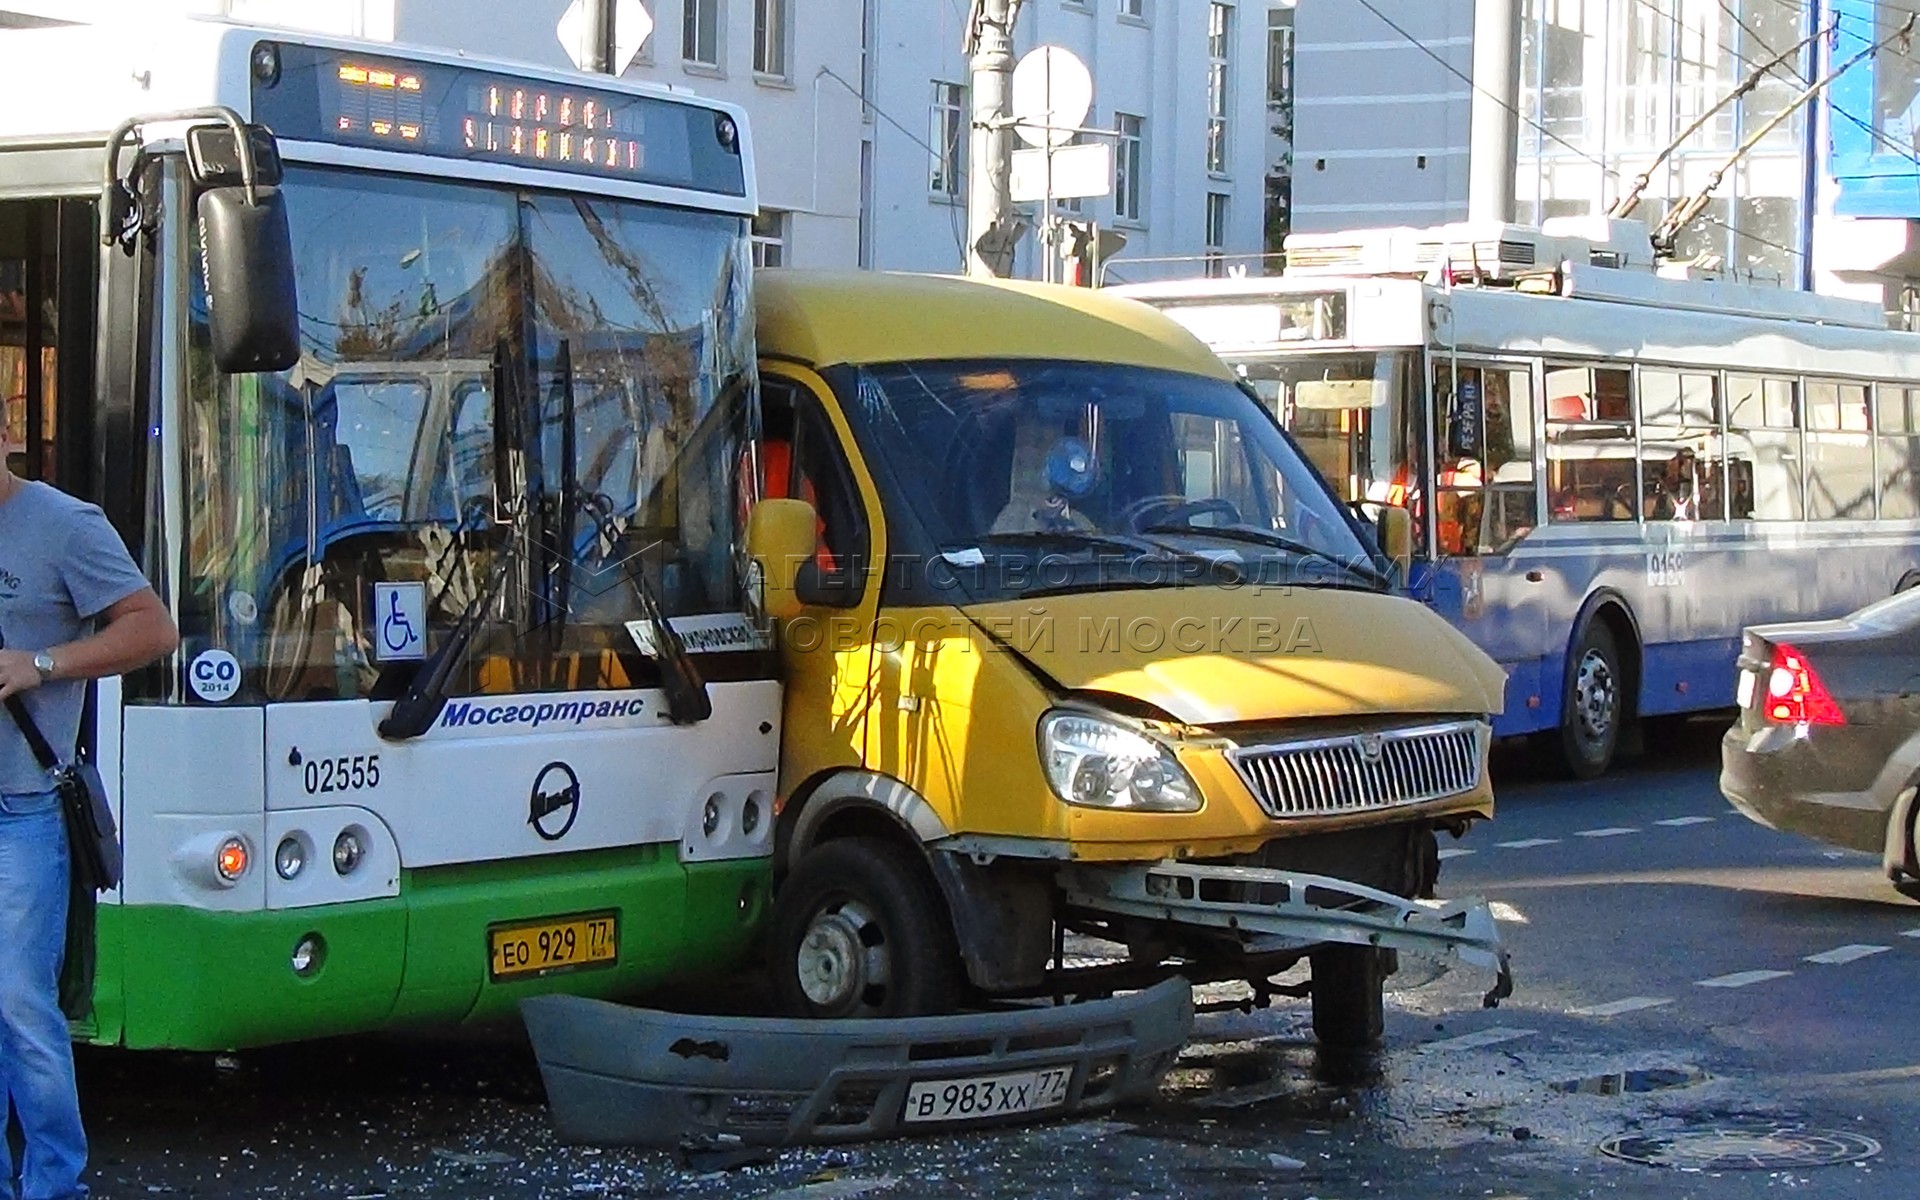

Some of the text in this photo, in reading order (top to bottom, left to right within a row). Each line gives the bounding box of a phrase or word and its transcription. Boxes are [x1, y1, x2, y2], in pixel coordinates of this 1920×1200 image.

[201, 682, 230, 692] 2014
[441, 699, 644, 727] Мосгортранс
[304, 755, 380, 794] 02555
[588, 922, 607, 946] 77
[1040, 1071, 1065, 1093] 77
